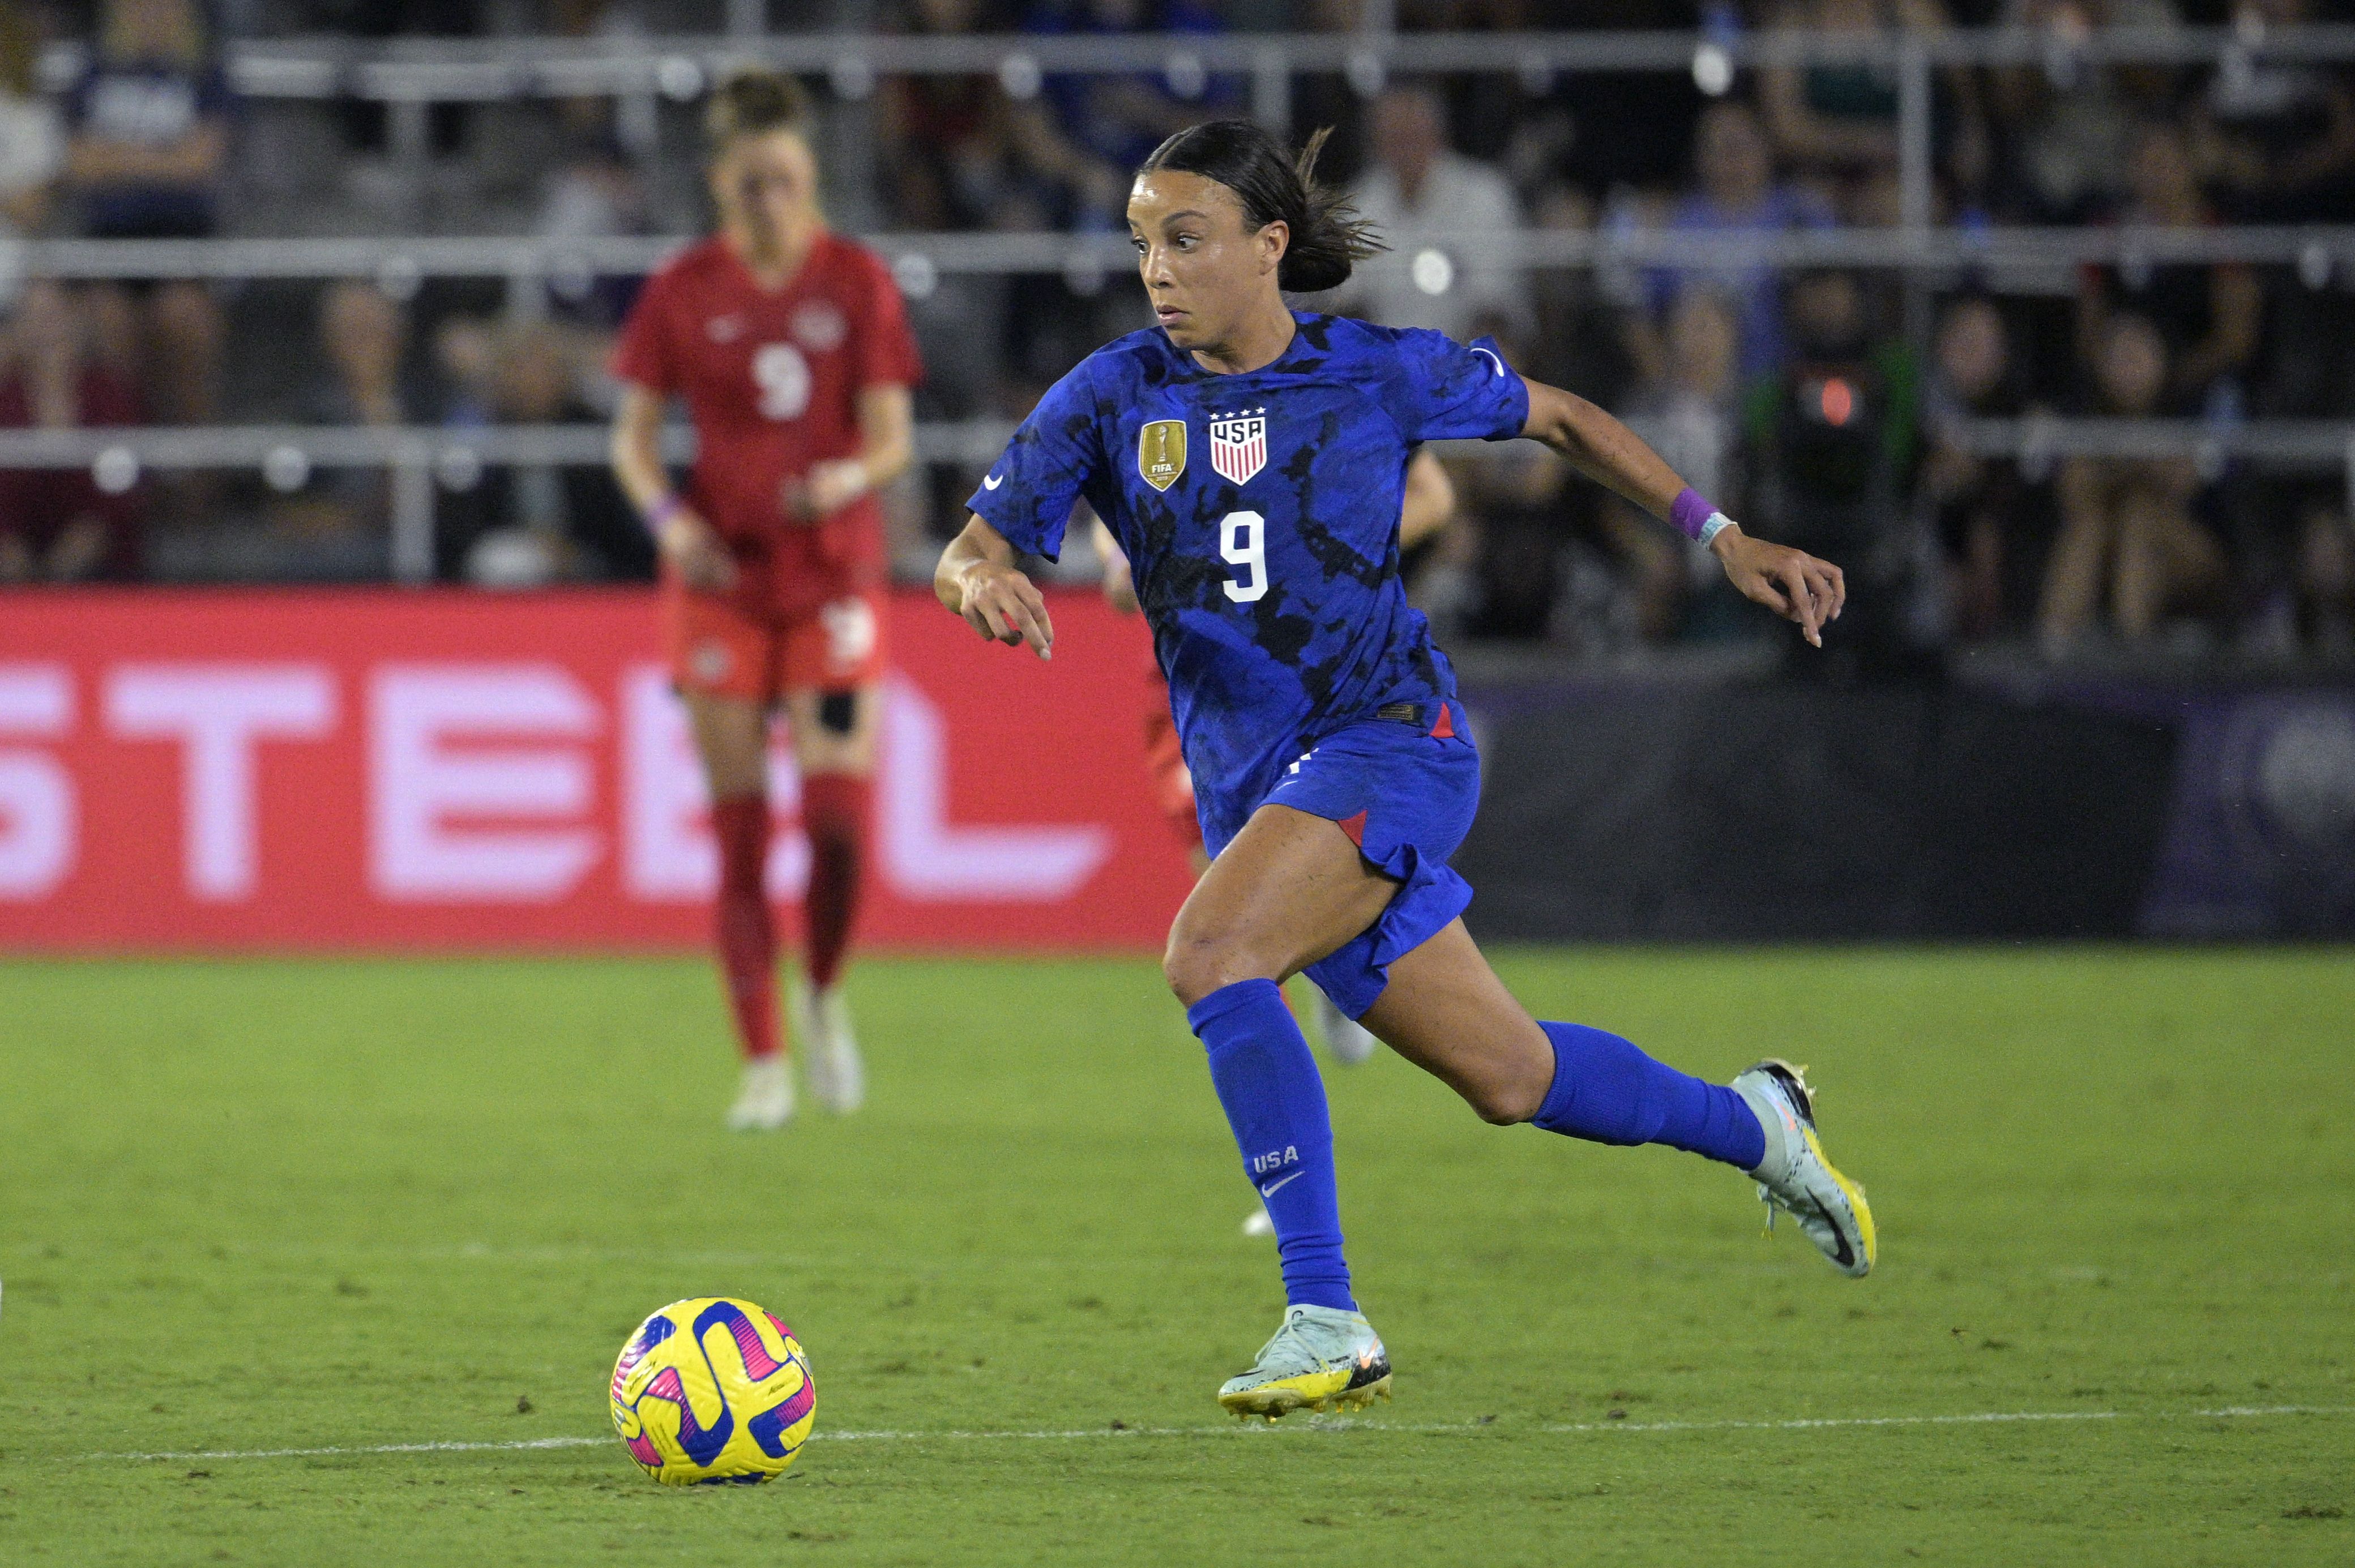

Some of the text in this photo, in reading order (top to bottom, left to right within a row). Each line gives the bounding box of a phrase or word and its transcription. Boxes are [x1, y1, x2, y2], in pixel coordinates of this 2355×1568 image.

[751, 343, 811, 420] 9
[1215, 420, 1261, 444] USA
[1152, 464, 1172, 473] FIFA
[1220, 511, 1268, 602] 9
[1254, 1146, 1298, 1173] USA
